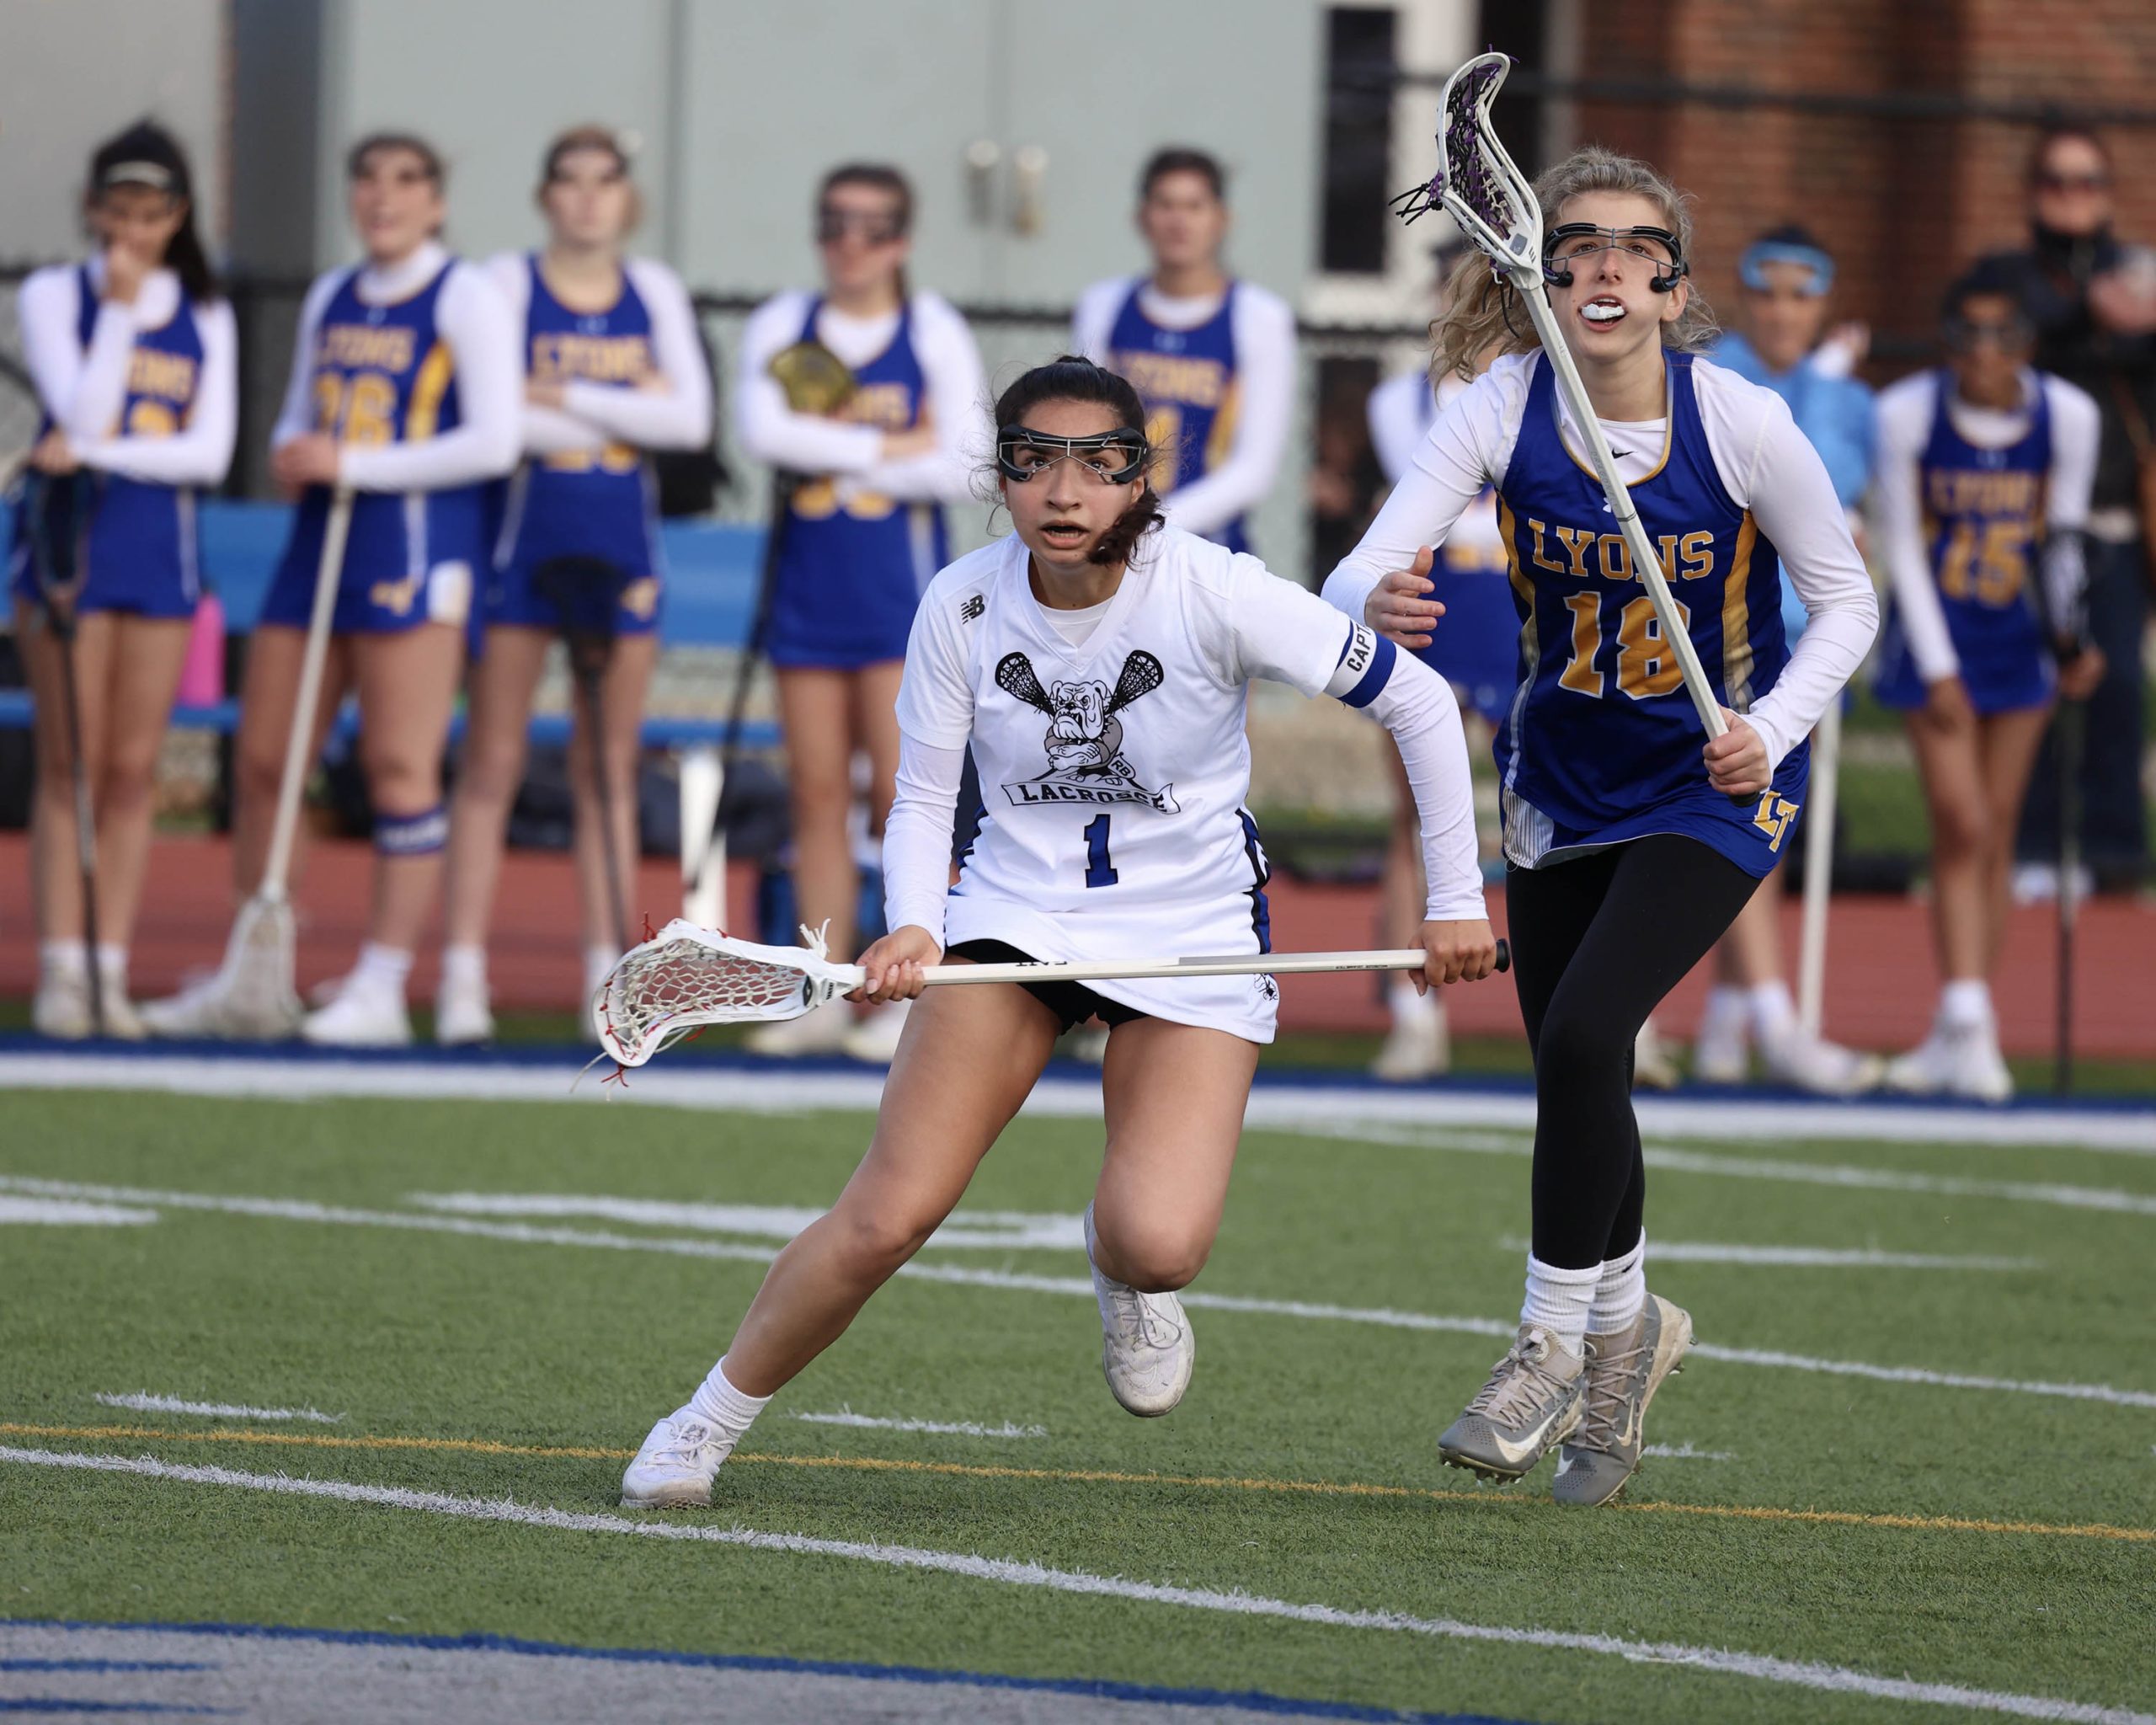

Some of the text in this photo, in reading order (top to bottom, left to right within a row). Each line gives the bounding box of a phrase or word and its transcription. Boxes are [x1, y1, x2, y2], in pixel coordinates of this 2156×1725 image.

[1529, 517, 1715, 584] LYONS
[1940, 521, 2025, 606] 15
[1558, 590, 1691, 701] 18
[1111, 760, 1131, 777] RB
[1083, 813, 1119, 889] 1
[1752, 790, 1800, 853] LT
